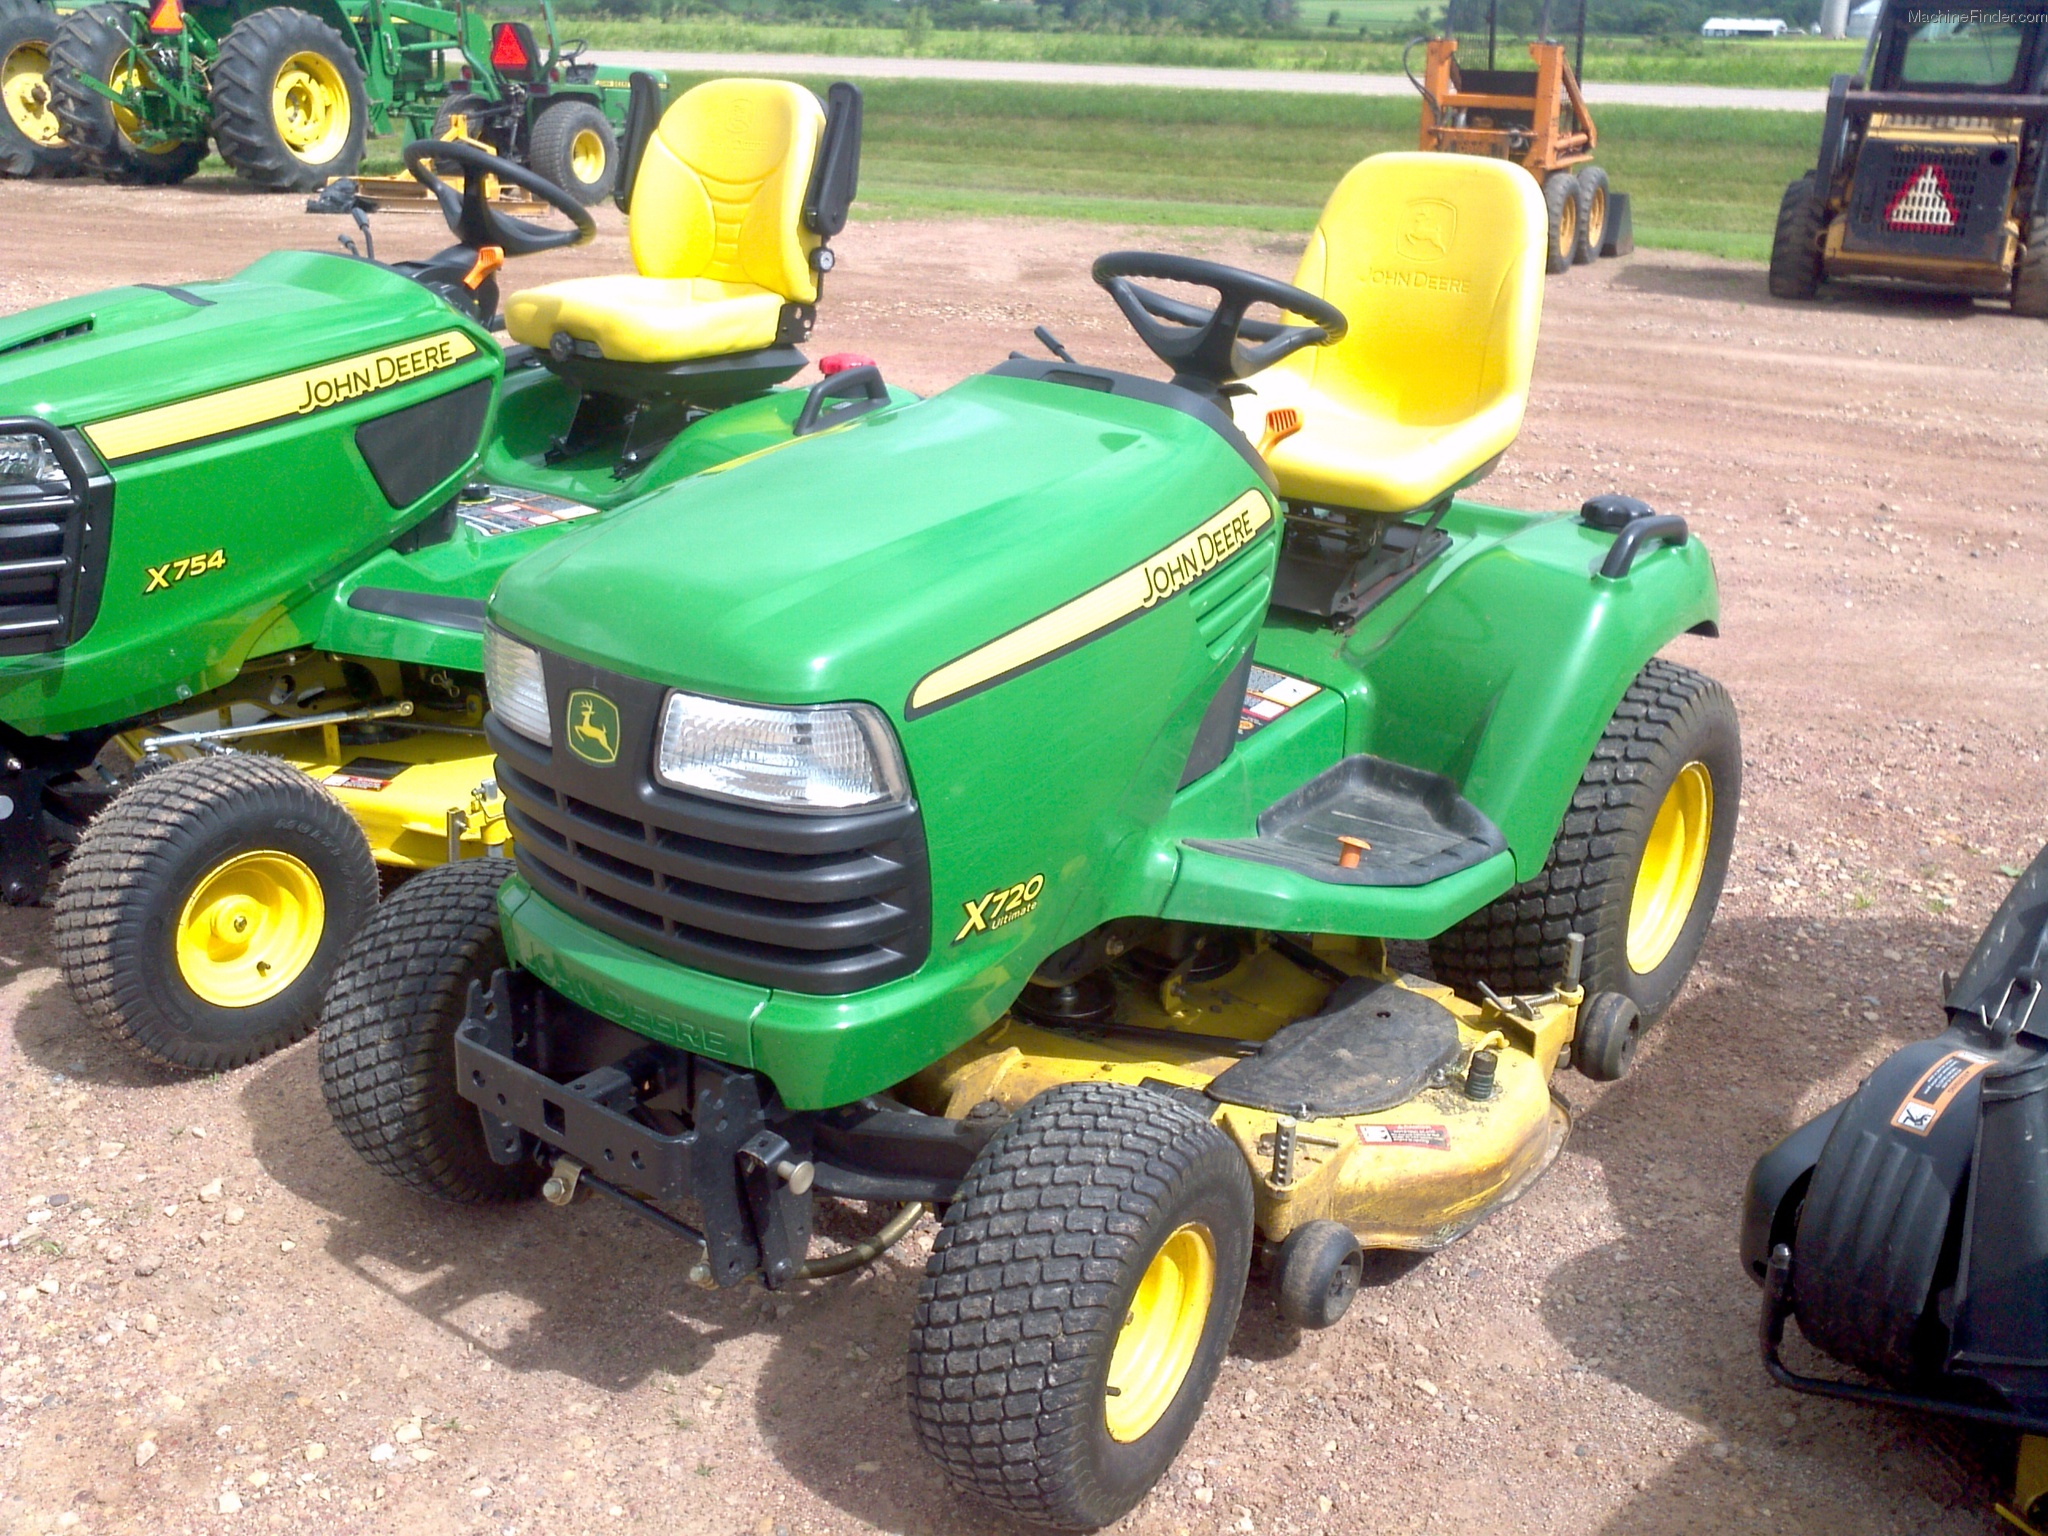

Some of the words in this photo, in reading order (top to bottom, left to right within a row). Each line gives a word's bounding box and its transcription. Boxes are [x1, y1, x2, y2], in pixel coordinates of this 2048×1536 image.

[1359, 266, 1411, 287] JOHN
[1413, 270, 1471, 293] DEERE
[298, 367, 371, 411] JOHN
[375, 341, 454, 384] DEERE
[144, 548, 226, 594] X754
[1143, 547, 1198, 604] JOHN
[1197, 509, 1253, 567] DEERE
[954, 873, 1045, 942] X720
[991, 901, 1038, 931] Ultimate
[602, 984, 729, 1057] DEERE
